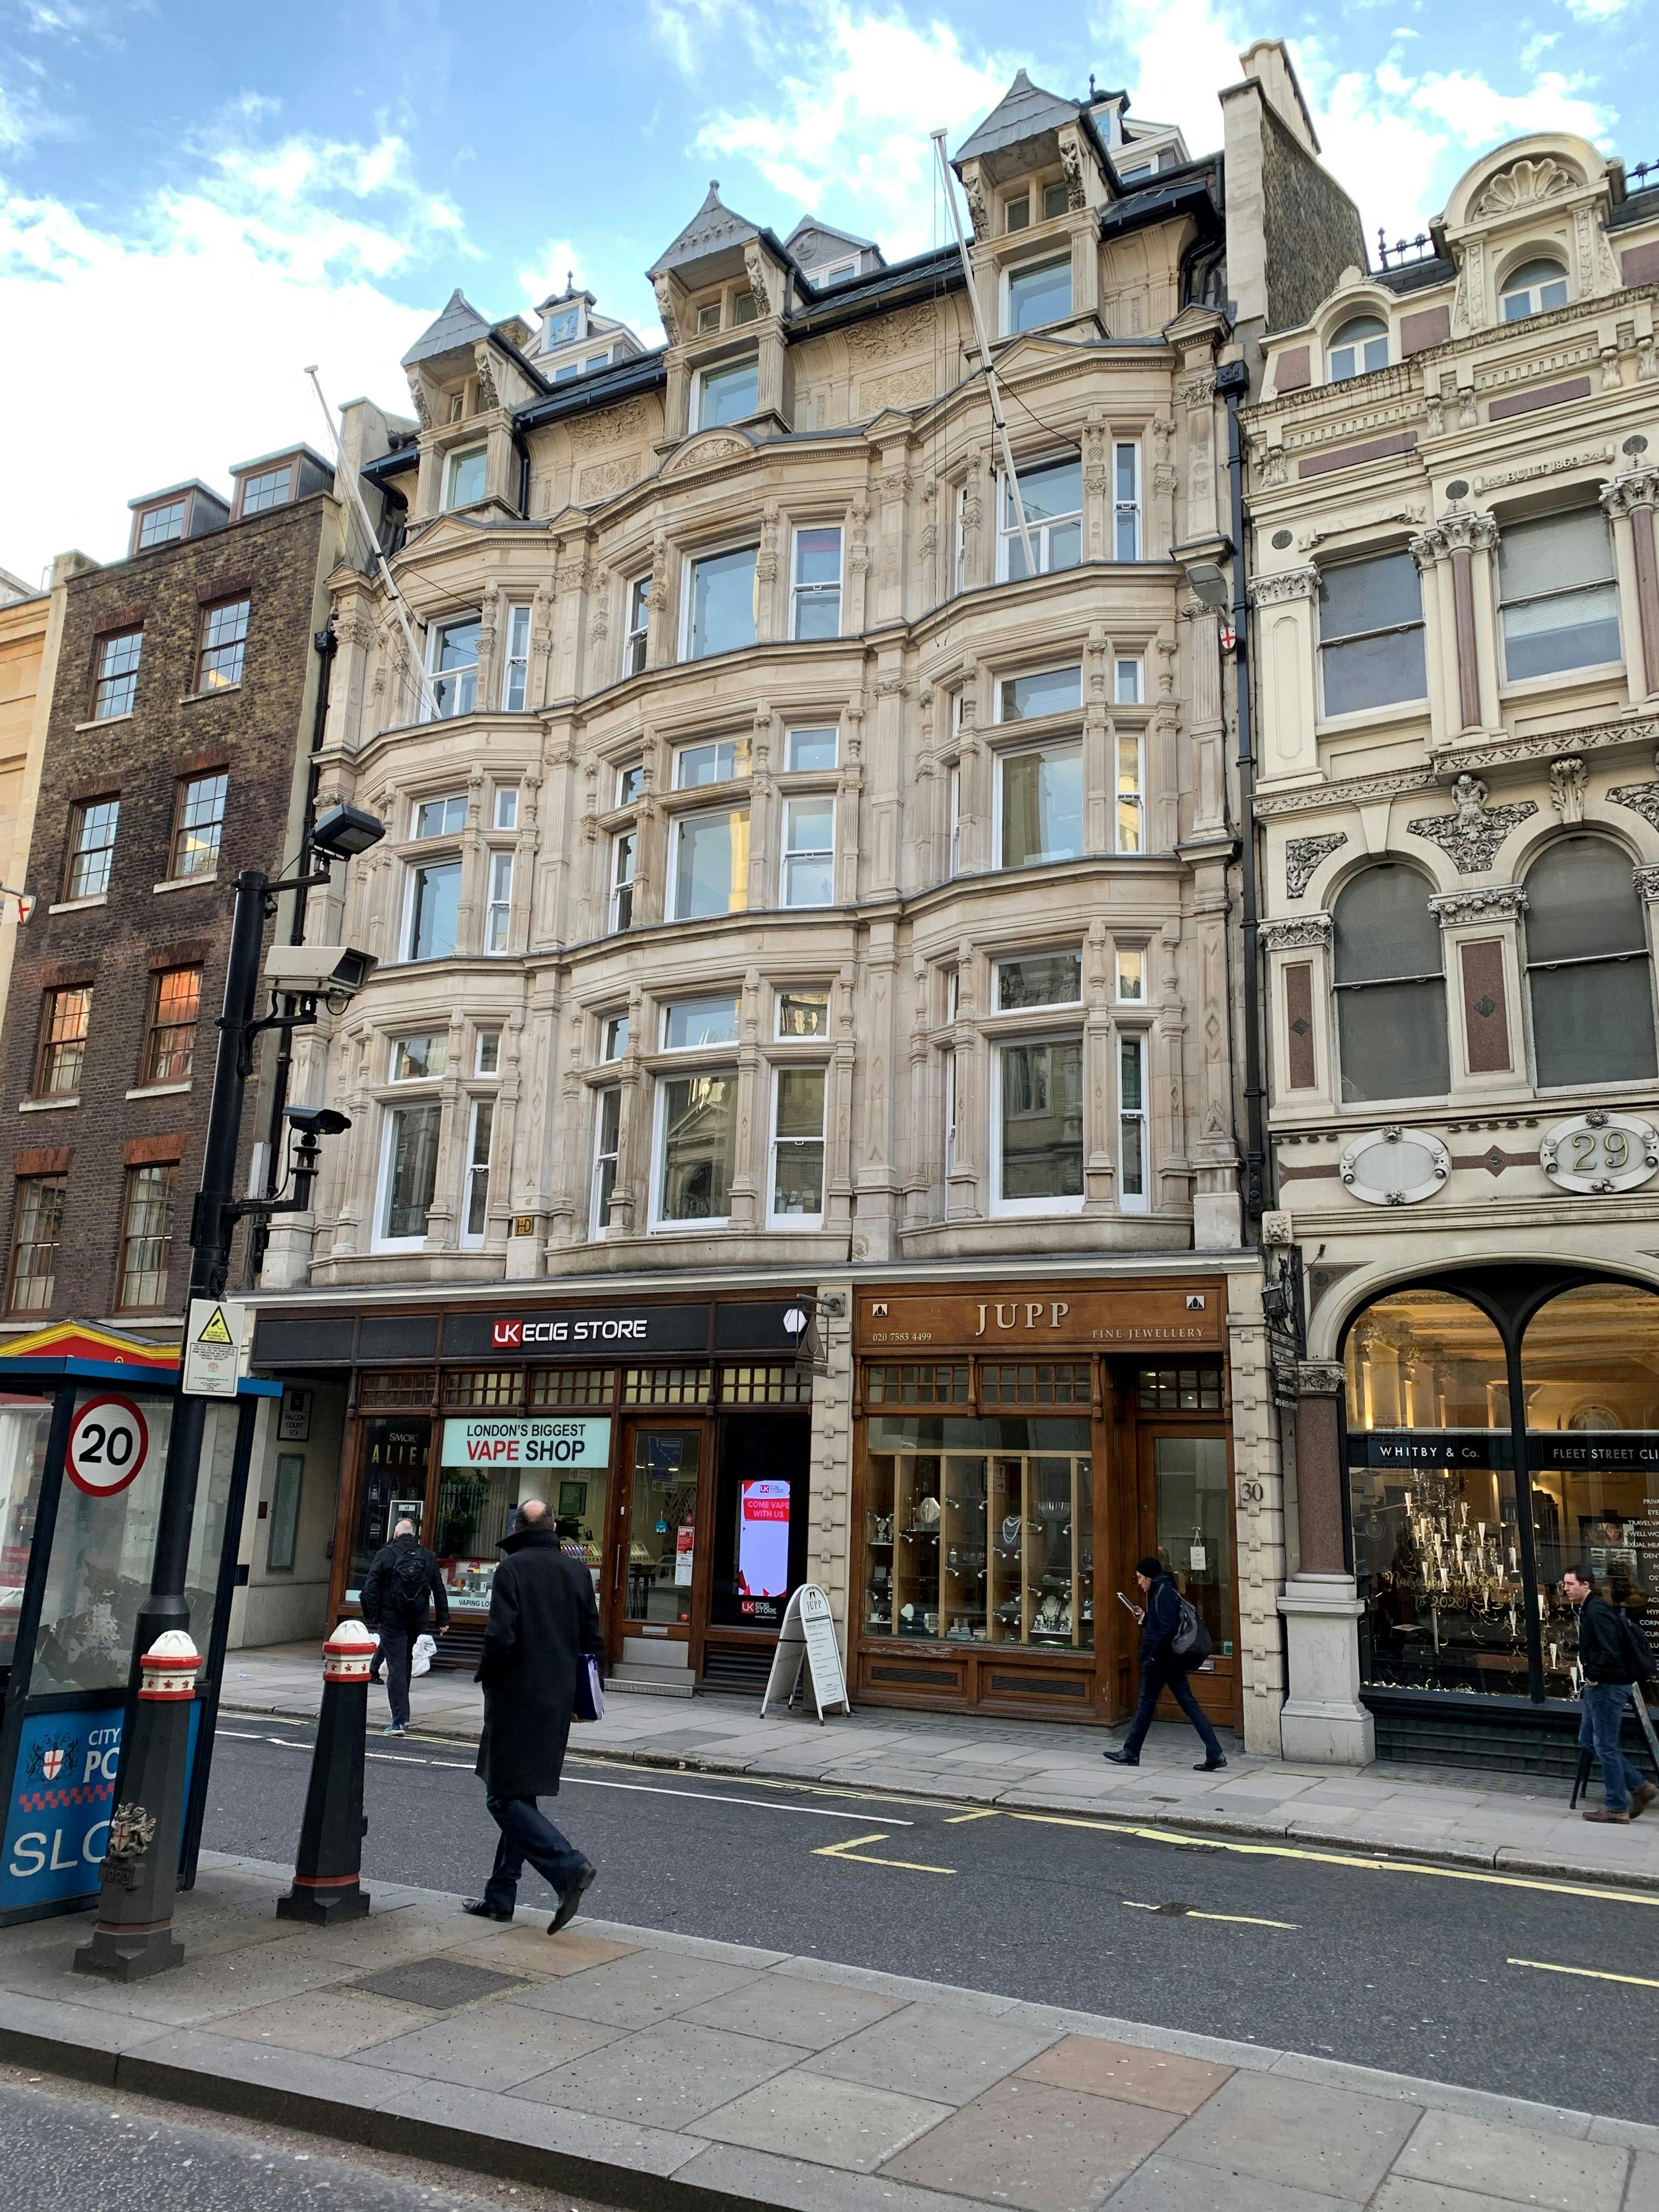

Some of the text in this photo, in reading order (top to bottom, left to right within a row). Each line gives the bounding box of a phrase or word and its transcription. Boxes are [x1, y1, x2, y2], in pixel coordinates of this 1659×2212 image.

[1506, 456, 1580, 483] BUILT 1860
[1573, 1131, 1629, 1171] 29
[975, 1302, 1069, 1336] JUPP
[574, 1319, 647, 1340] STORE
[873, 1332, 932, 1341] 020 7583 4499
[1092, 1328, 1205, 1341] FINE JEWELLERY
[390, 1433, 416, 1443] SMOK
[467, 1424, 586, 1437] LONDON'S BIGGEST
[78, 1424, 133, 1465] 20
[467, 1440, 585, 1461] VAPE SHOP
[1380, 1446, 1480, 1458] WHITBY & Co.
[1553, 1448, 1659, 1459] FLEET STREET CLI
[1240, 1483, 1263, 1501] 30
[742, 1602, 754, 1612] UK
[806, 1600, 821, 1613] JUPP
[88, 1728, 121, 1746] CITY
